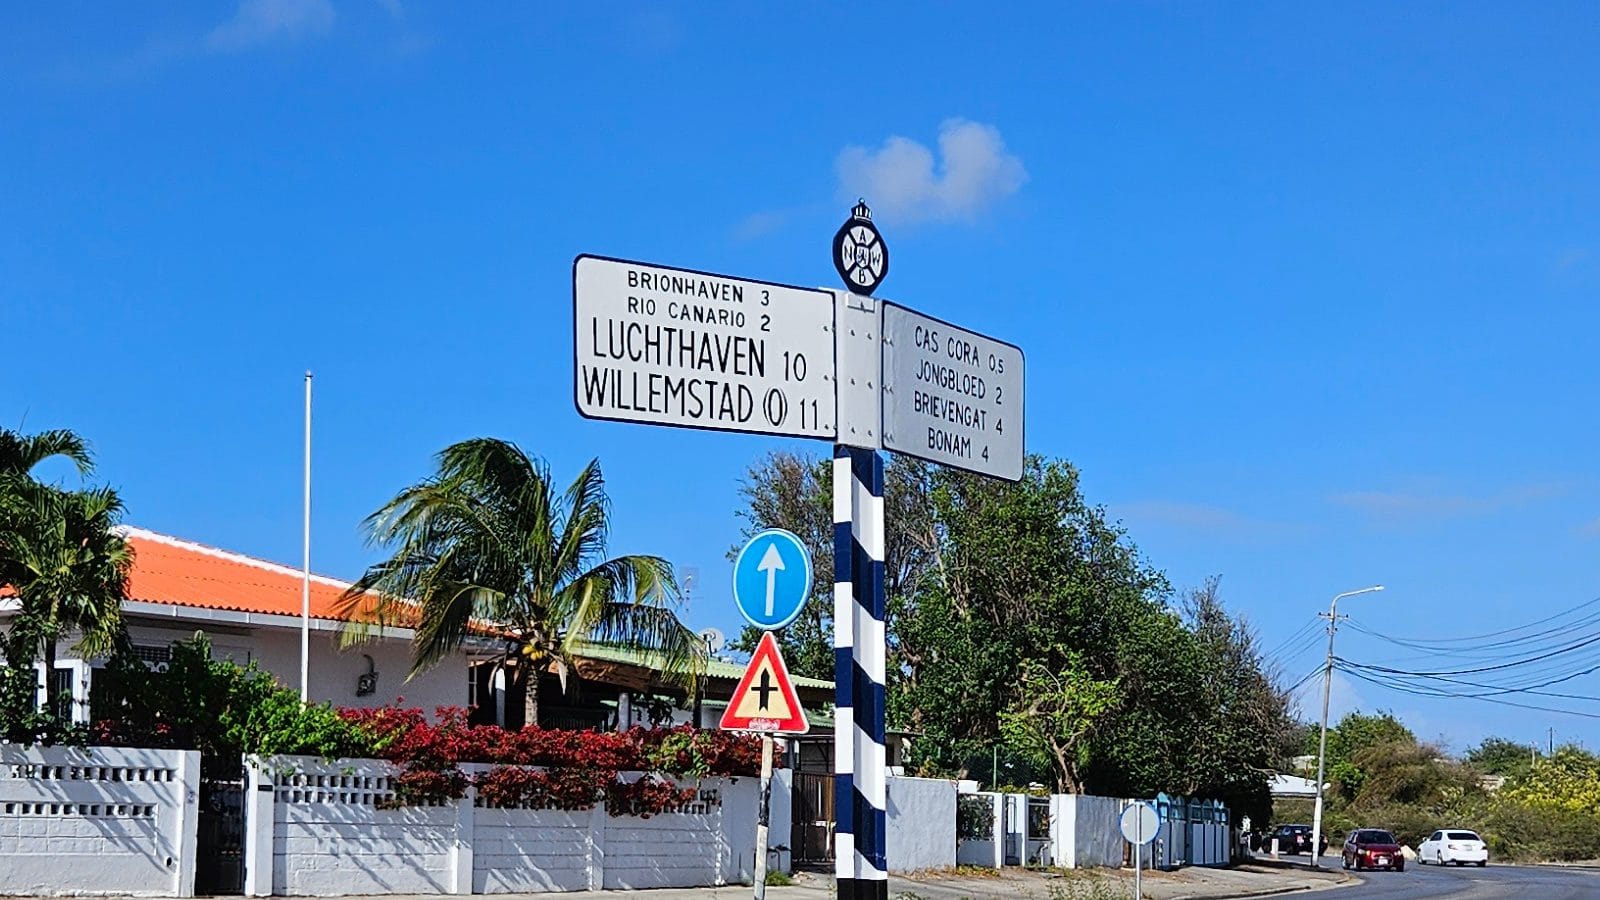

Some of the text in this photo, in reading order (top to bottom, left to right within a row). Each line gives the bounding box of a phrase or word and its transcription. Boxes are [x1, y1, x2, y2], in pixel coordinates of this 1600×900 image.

[628, 270, 770, 307] BRIONHAVEN 3
[628, 296, 771, 332] RIO CANARIO 2
[592, 316, 807, 382] LUCHTHAVEN 10
[914, 325, 939, 353] CAS
[947, 336, 980, 368] CORA
[582, 364, 754, 423] WILLEMSTAD
[800, 398, 818, 431] 11
[916, 359, 1003, 405] JONGBLOED 2
[914, 390, 1003, 436] BRIEVENGAT 4
[928, 426, 989, 463] BONAM 4
